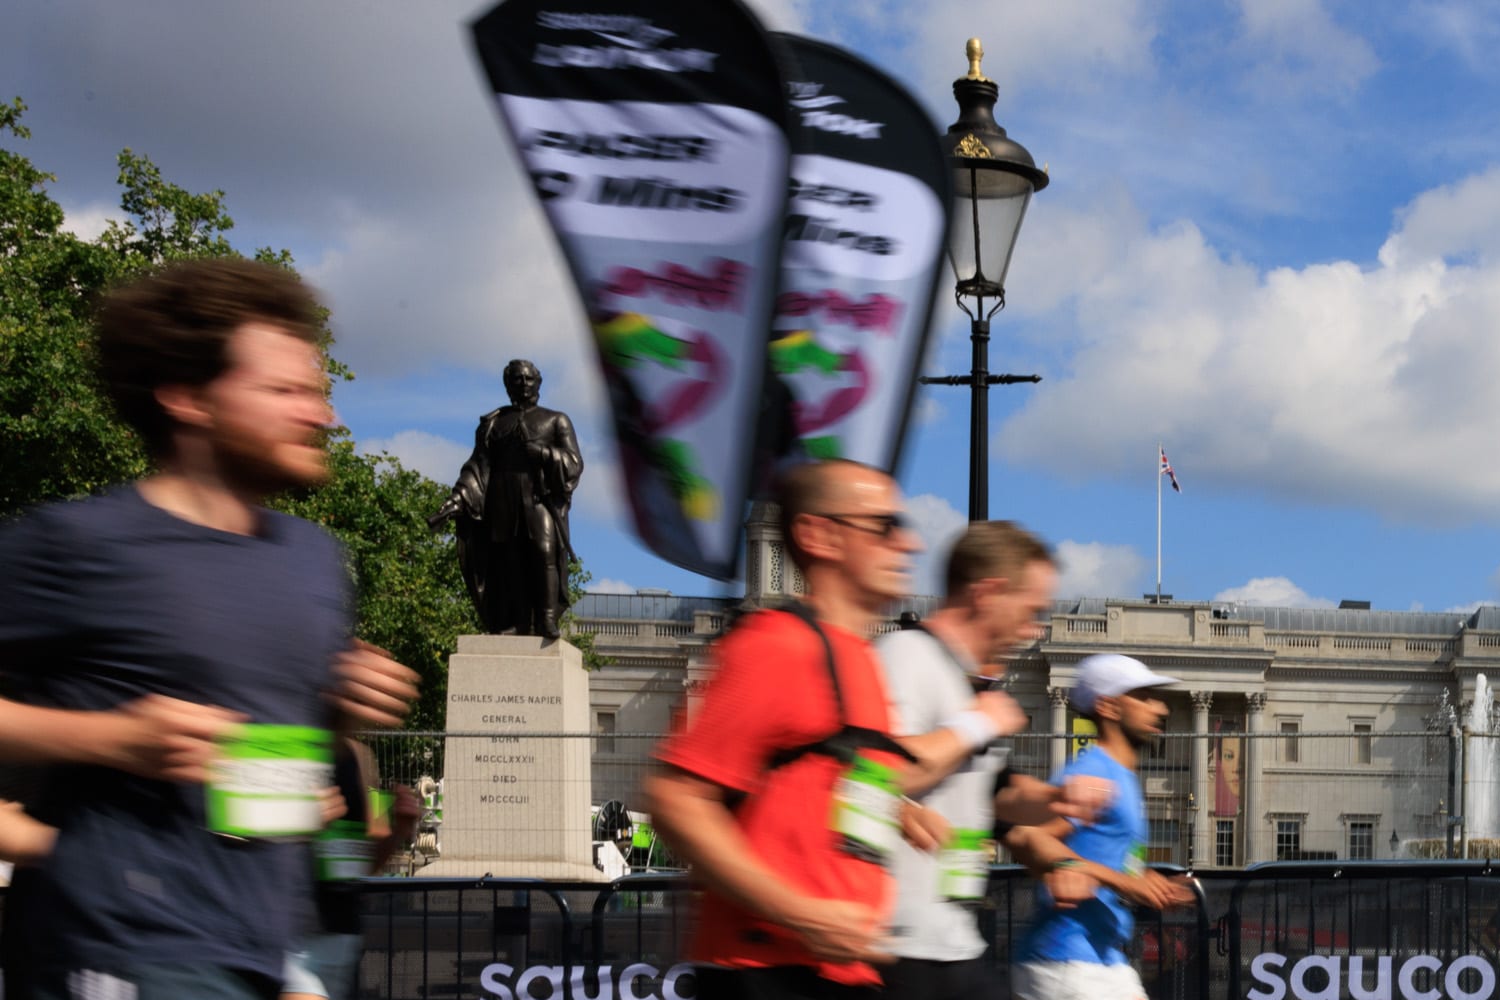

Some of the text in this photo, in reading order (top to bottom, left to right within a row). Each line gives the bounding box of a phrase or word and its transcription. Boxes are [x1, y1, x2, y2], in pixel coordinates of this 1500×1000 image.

[451, 694, 562, 705] CHARLES JAMES NAPIER
[482, 715, 527, 724] GENERAL
[491, 735, 520, 744] BORN
[475, 754, 535, 764] MDCCLXXXII
[492, 775, 518, 783] DIED
[480, 794, 530, 804] MDCCCLIII
